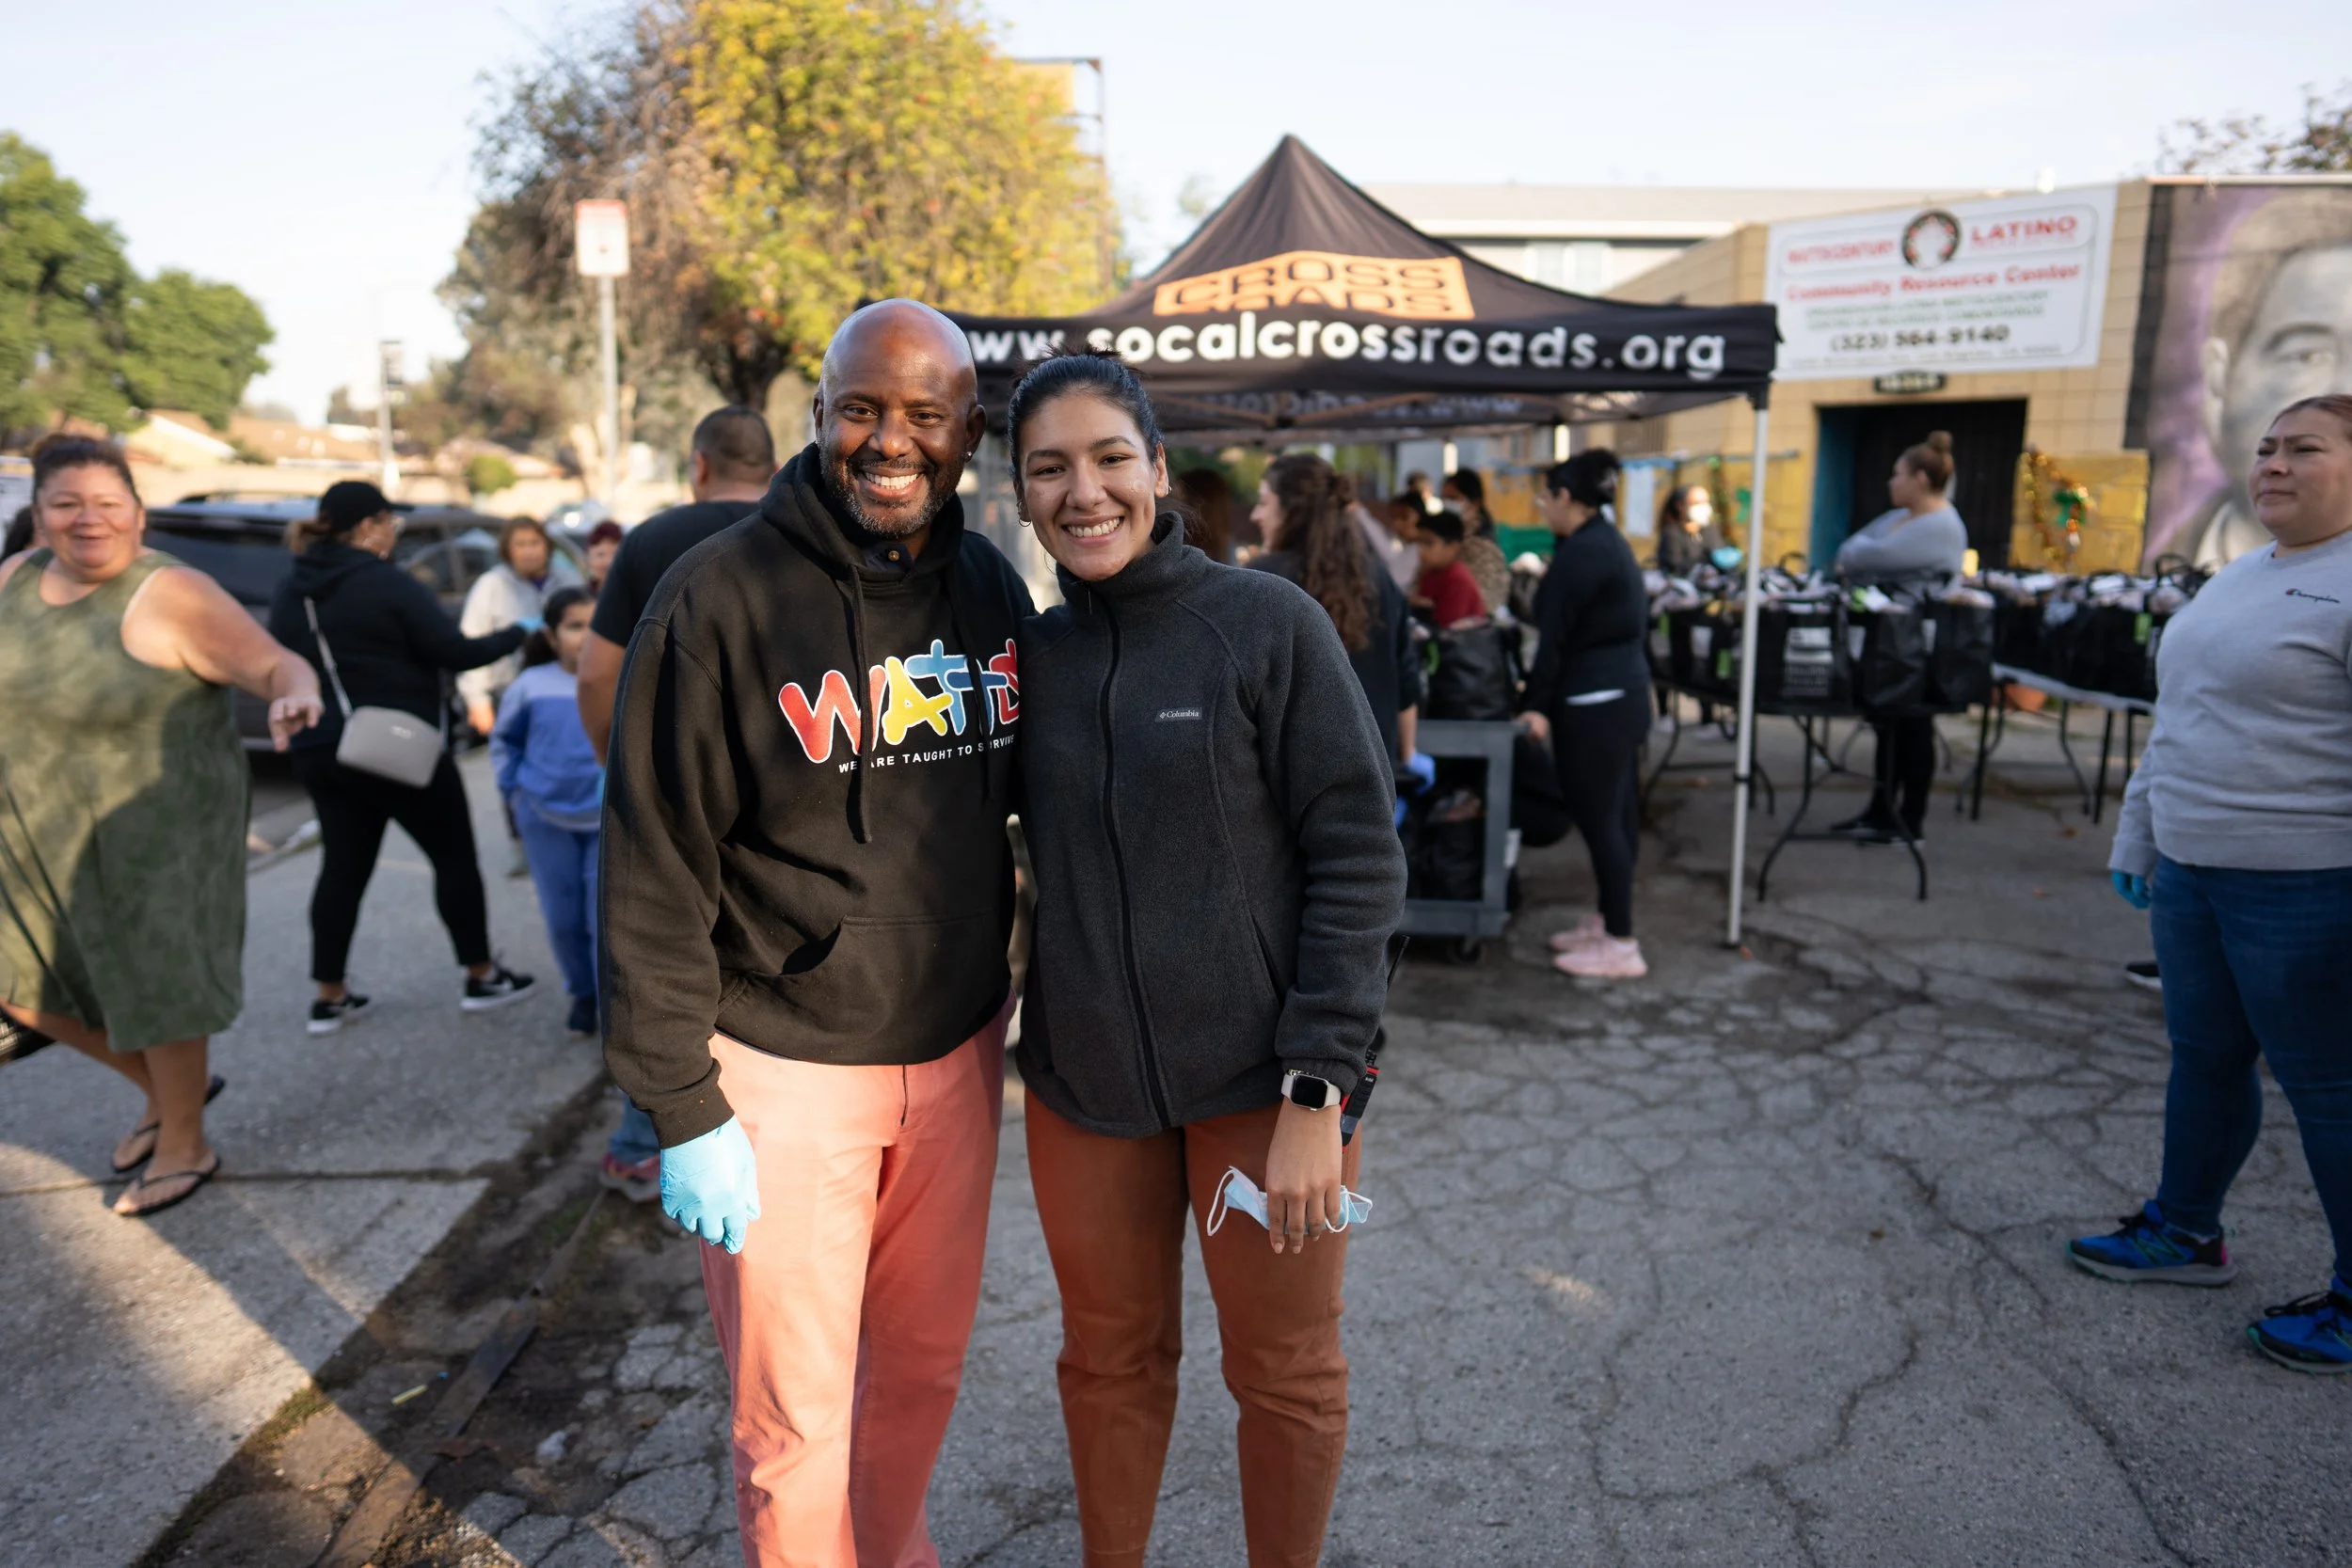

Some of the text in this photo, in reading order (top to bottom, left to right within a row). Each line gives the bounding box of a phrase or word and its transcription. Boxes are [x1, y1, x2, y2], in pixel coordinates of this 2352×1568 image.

[1971, 215, 2077, 244] LATINO
[1175, 258, 1445, 306] CROSS
[1788, 264, 2079, 301] Community Resource Center
[1830, 331, 1889, 352] (323)
[1167, 709, 1200, 719] Columbia
[838, 760, 858, 773] WE
[902, 749, 953, 764] TAUGHT
[958, 745, 973, 757] TO
